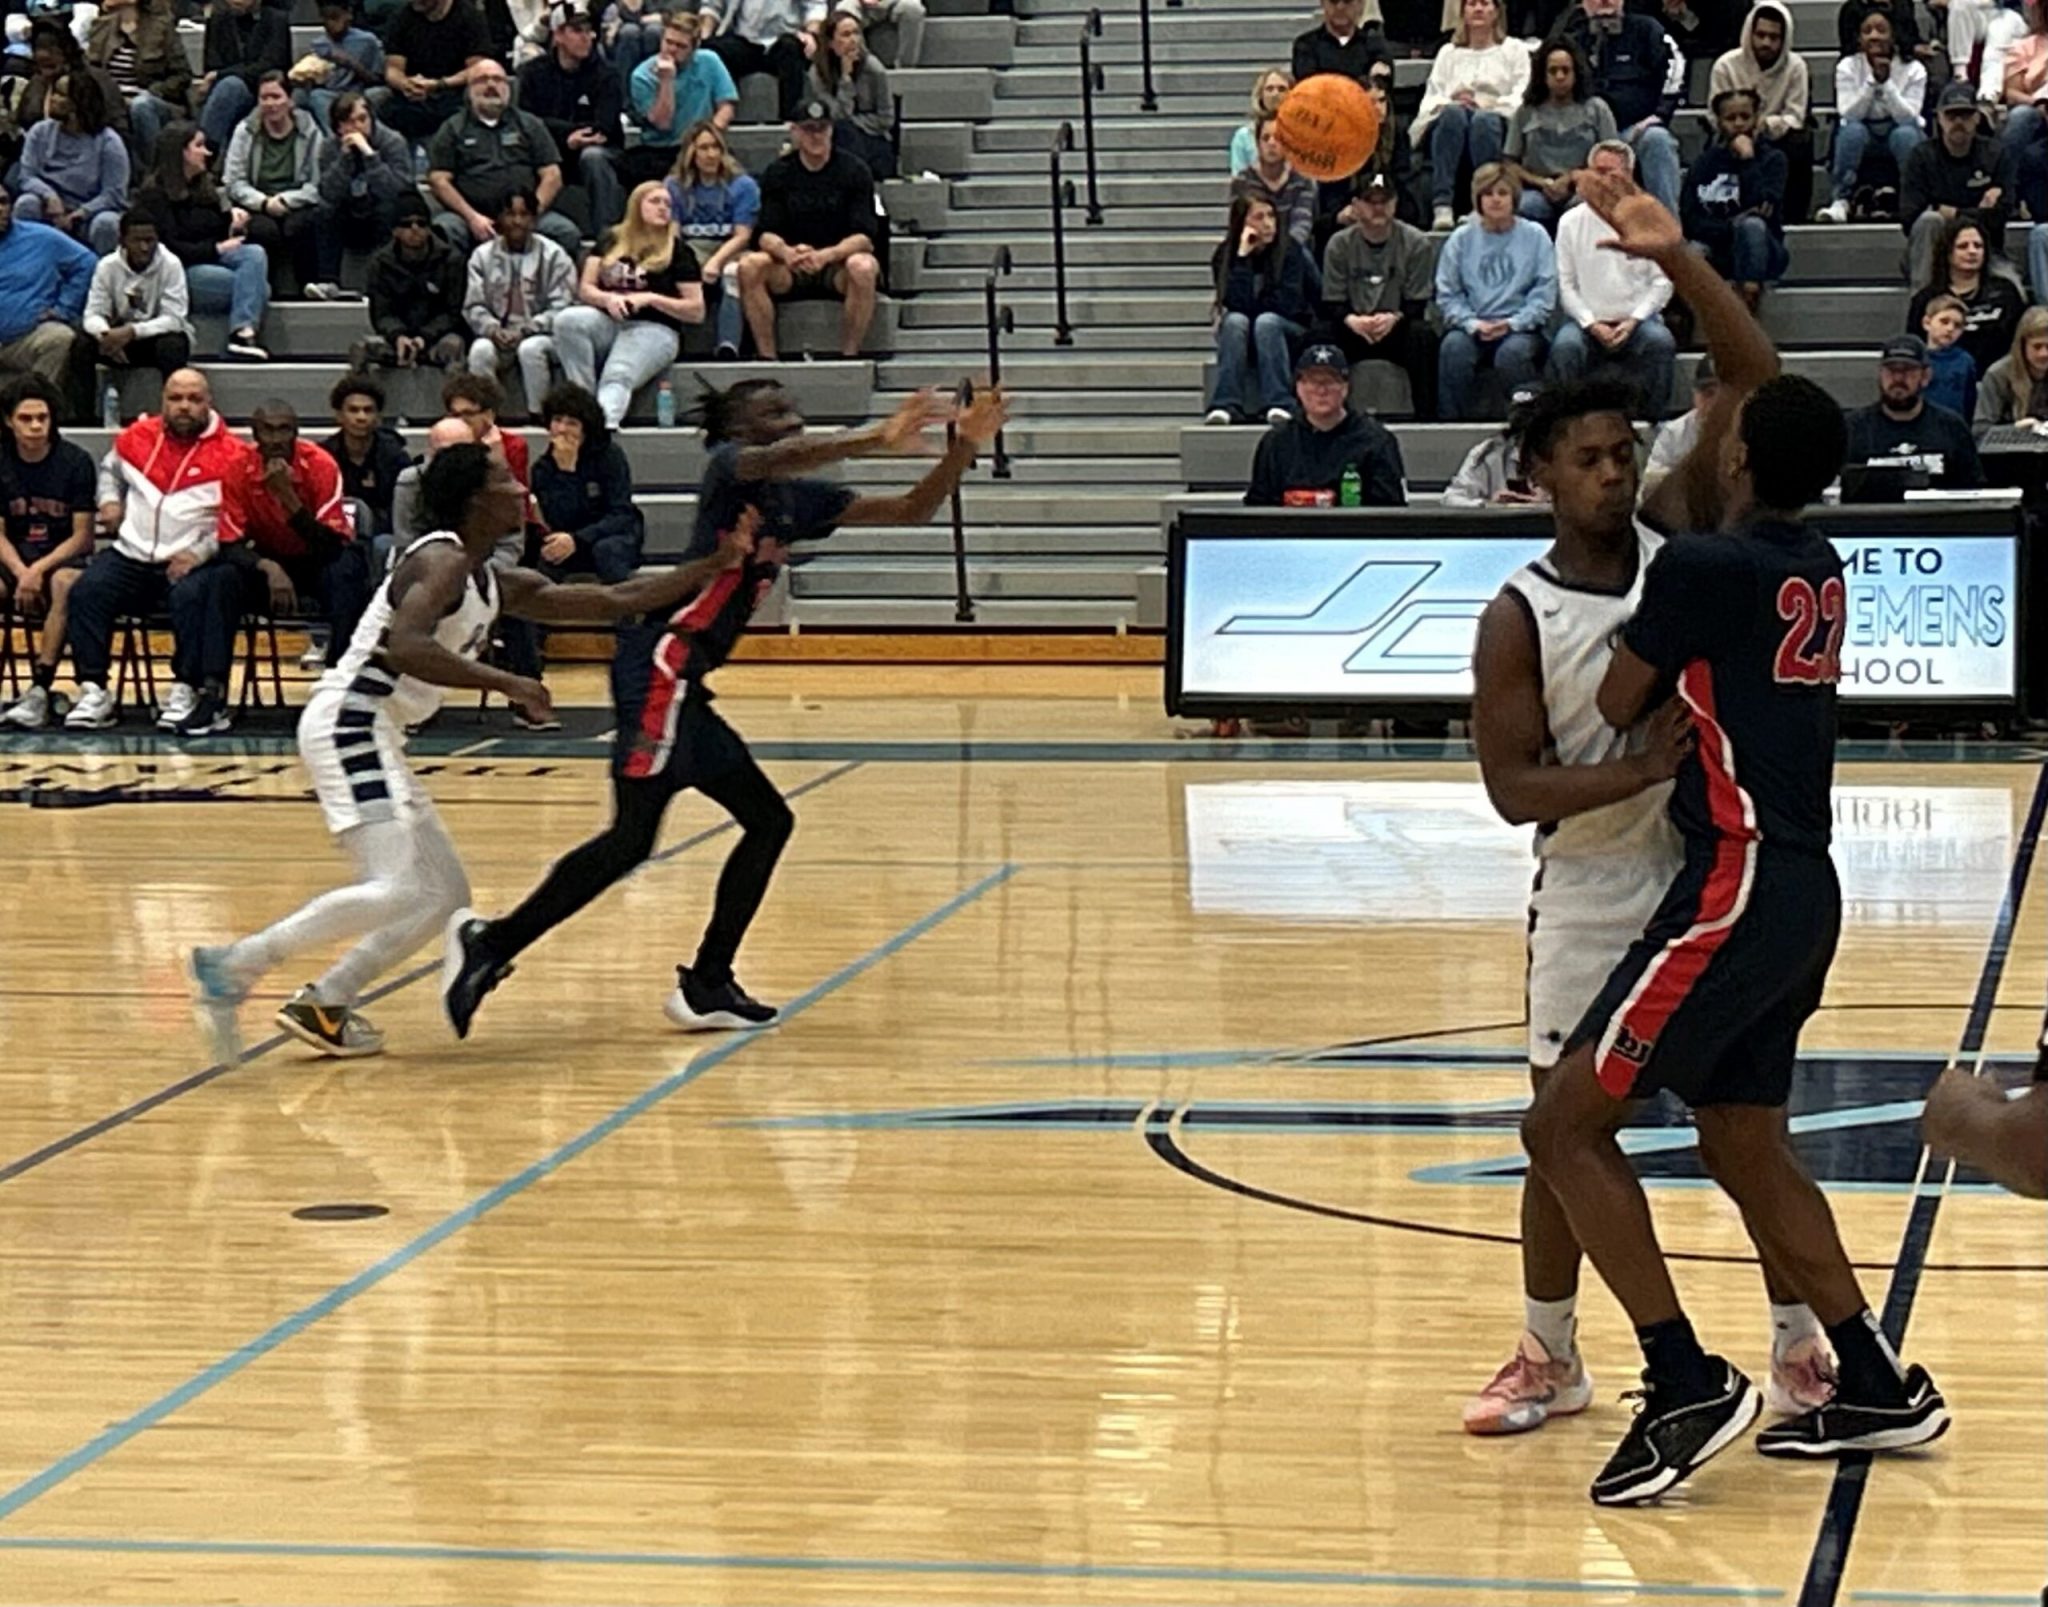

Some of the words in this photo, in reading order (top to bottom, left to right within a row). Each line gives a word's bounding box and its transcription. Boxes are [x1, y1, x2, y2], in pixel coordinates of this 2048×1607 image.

[1841, 548, 1882, 575] ME
[1893, 548, 1942, 575] TO
[1850, 584, 2006, 648] EMENS
[1838, 657, 1944, 685] HOOL
